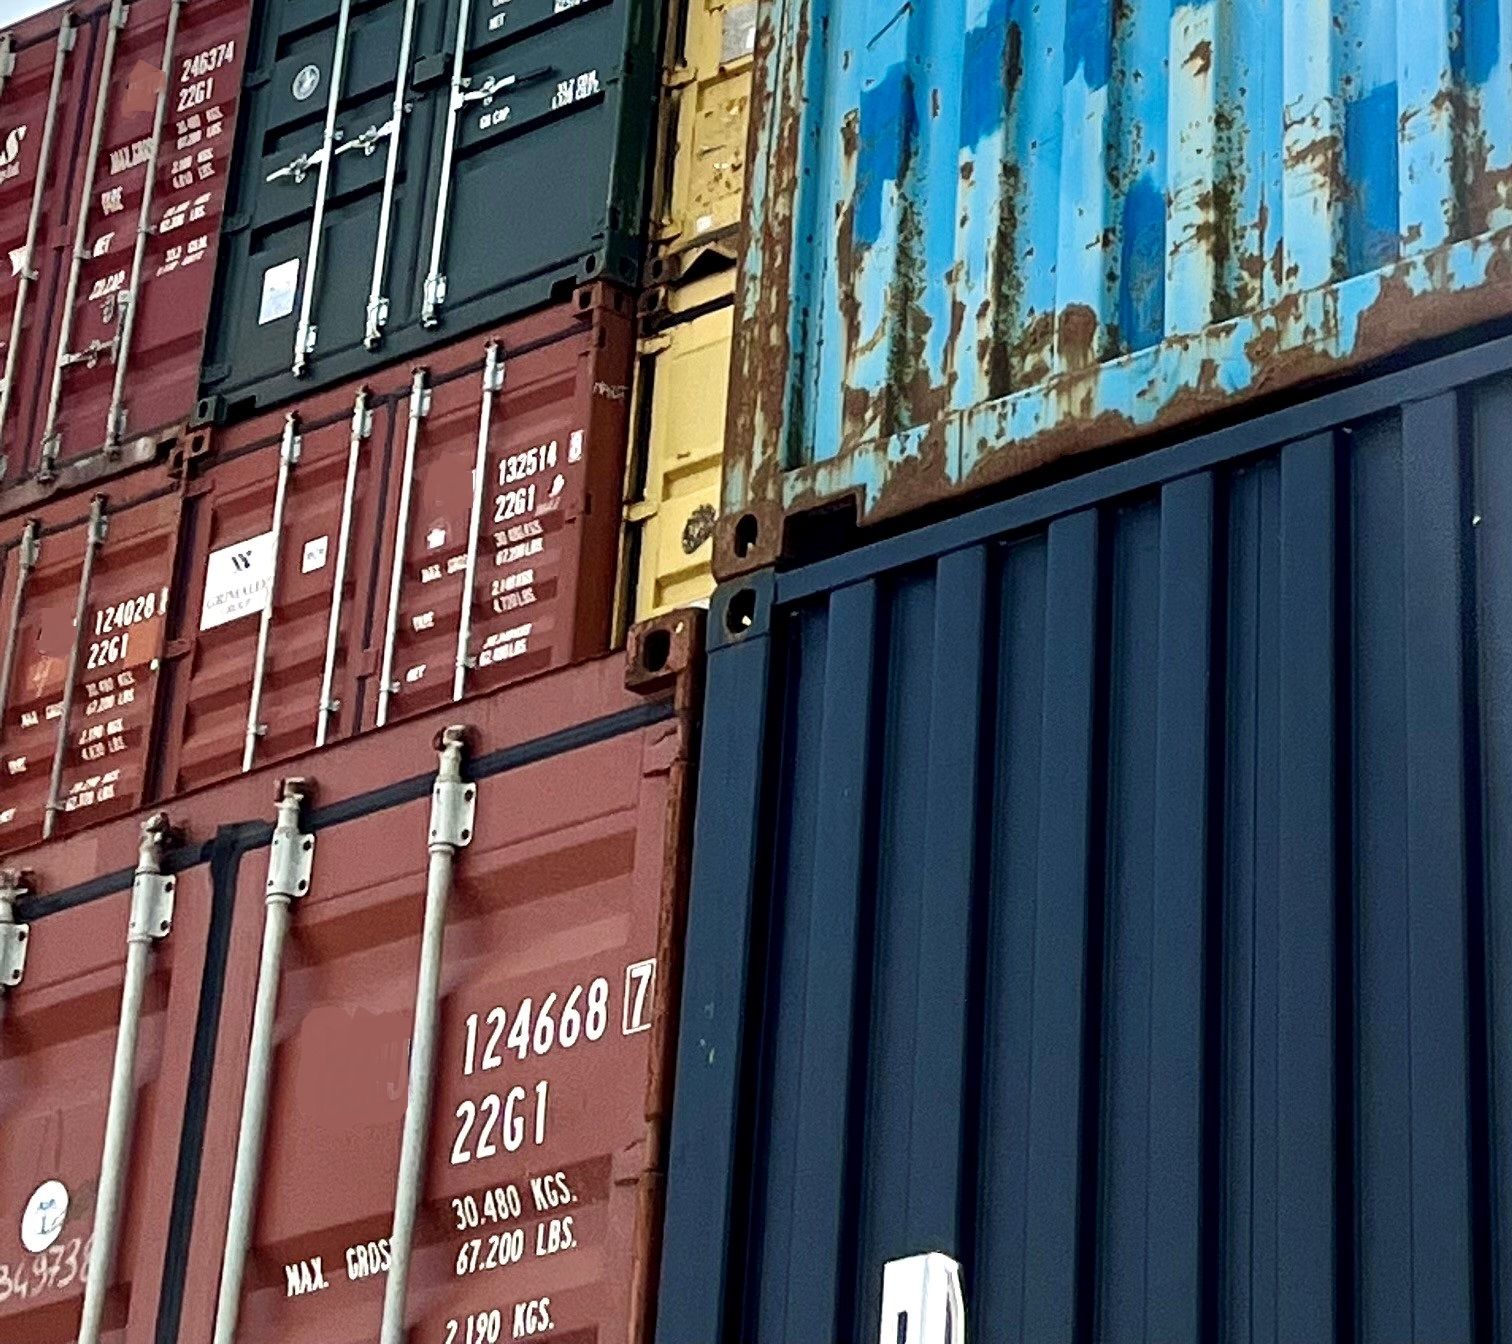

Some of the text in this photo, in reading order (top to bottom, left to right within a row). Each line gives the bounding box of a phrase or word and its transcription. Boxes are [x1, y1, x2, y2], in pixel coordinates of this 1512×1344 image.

[180, 40, 235, 83] 246374
[176, 77, 215, 112] 22G1
[498, 440, 557, 487] 132514
[494, 483, 536, 523] 22G1
[94, 592, 156, 636] 124028
[86, 632, 130, 670] 22G1
[463, 962, 653, 1076] 124668 7
[450, 1079, 549, 1165] 22G1
[451, 1171, 578, 1231] 30.480 KGS.
[285, 1236, 394, 1297] MAX. GROS
[455, 1215, 577, 1276] 67.200 LBS.
[445, 1297, 555, 1344] 2190 KGS.
